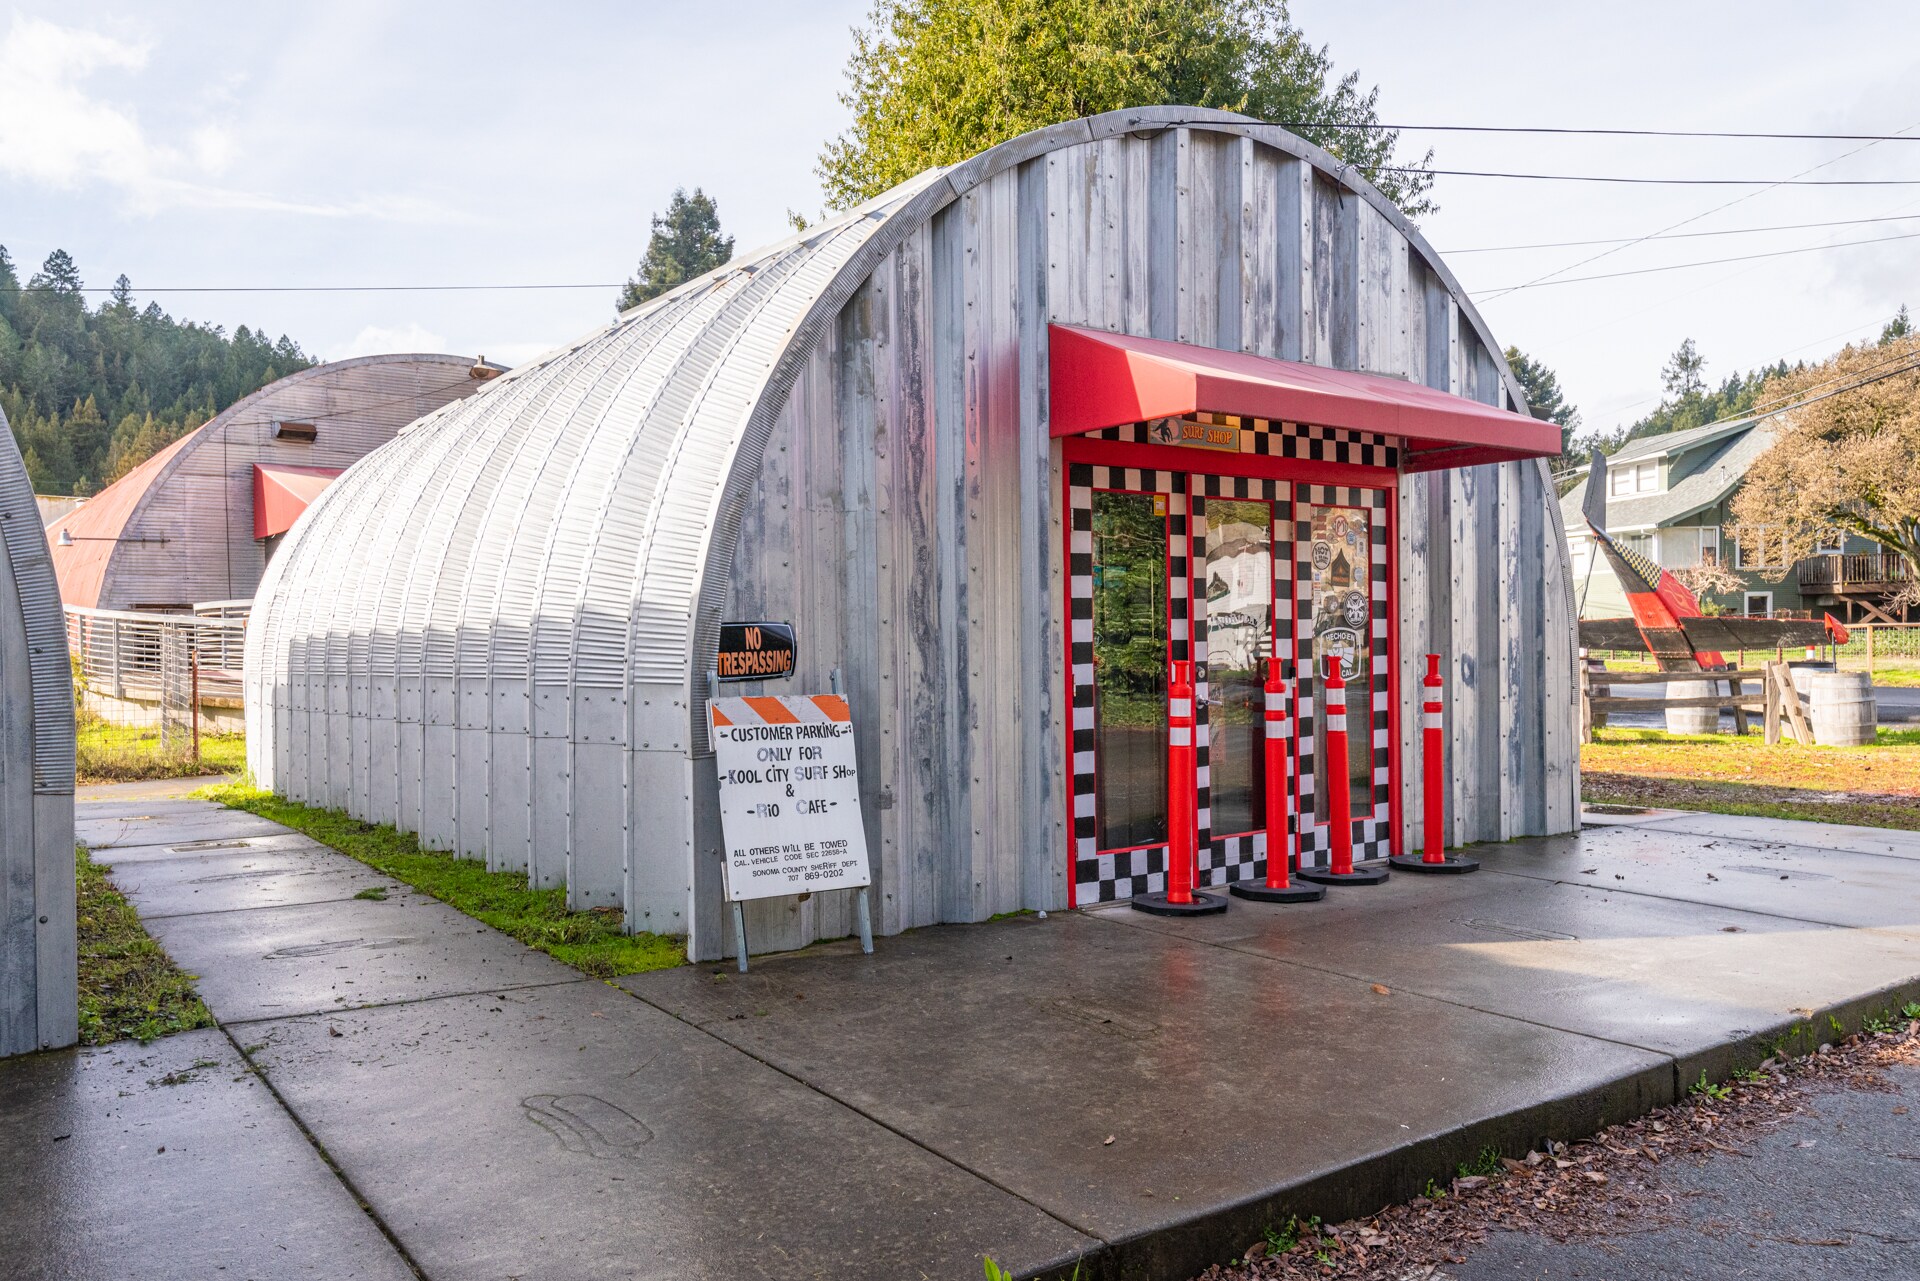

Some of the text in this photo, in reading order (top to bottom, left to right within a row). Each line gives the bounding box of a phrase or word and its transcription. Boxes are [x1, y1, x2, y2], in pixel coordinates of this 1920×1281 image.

[1182, 425, 1233, 445] SURF SHOP
[745, 627, 761, 650] NO
[1326, 632, 1346, 641] HECHO
[718, 649, 791, 675] TRESPASSING
[1341, 668, 1353, 677] CAL
[731, 726, 793, 742] CUSTOMER
[757, 745, 822, 762] ONLY FOR
[728, 769, 762, 784] KOOL
[794, 766, 828, 781] SURF
[785, 783, 795, 797] &
[796, 799, 828, 815] CAFE
[734, 849, 746, 858] ALL
[749, 845, 780, 856] OTHERS
[804, 843, 815, 851] BE
[820, 839, 848, 849] TOWED
[734, 860, 750, 868] CAL.
[751, 856, 778, 865] VEHICLE
[784, 853, 803, 861] CODE
[806, 851, 819, 859] SEC
[752, 869, 780, 877] SONOMA
[782, 866, 807, 874] COUNTY
[788, 869, 844, 882] 707 869-0202
